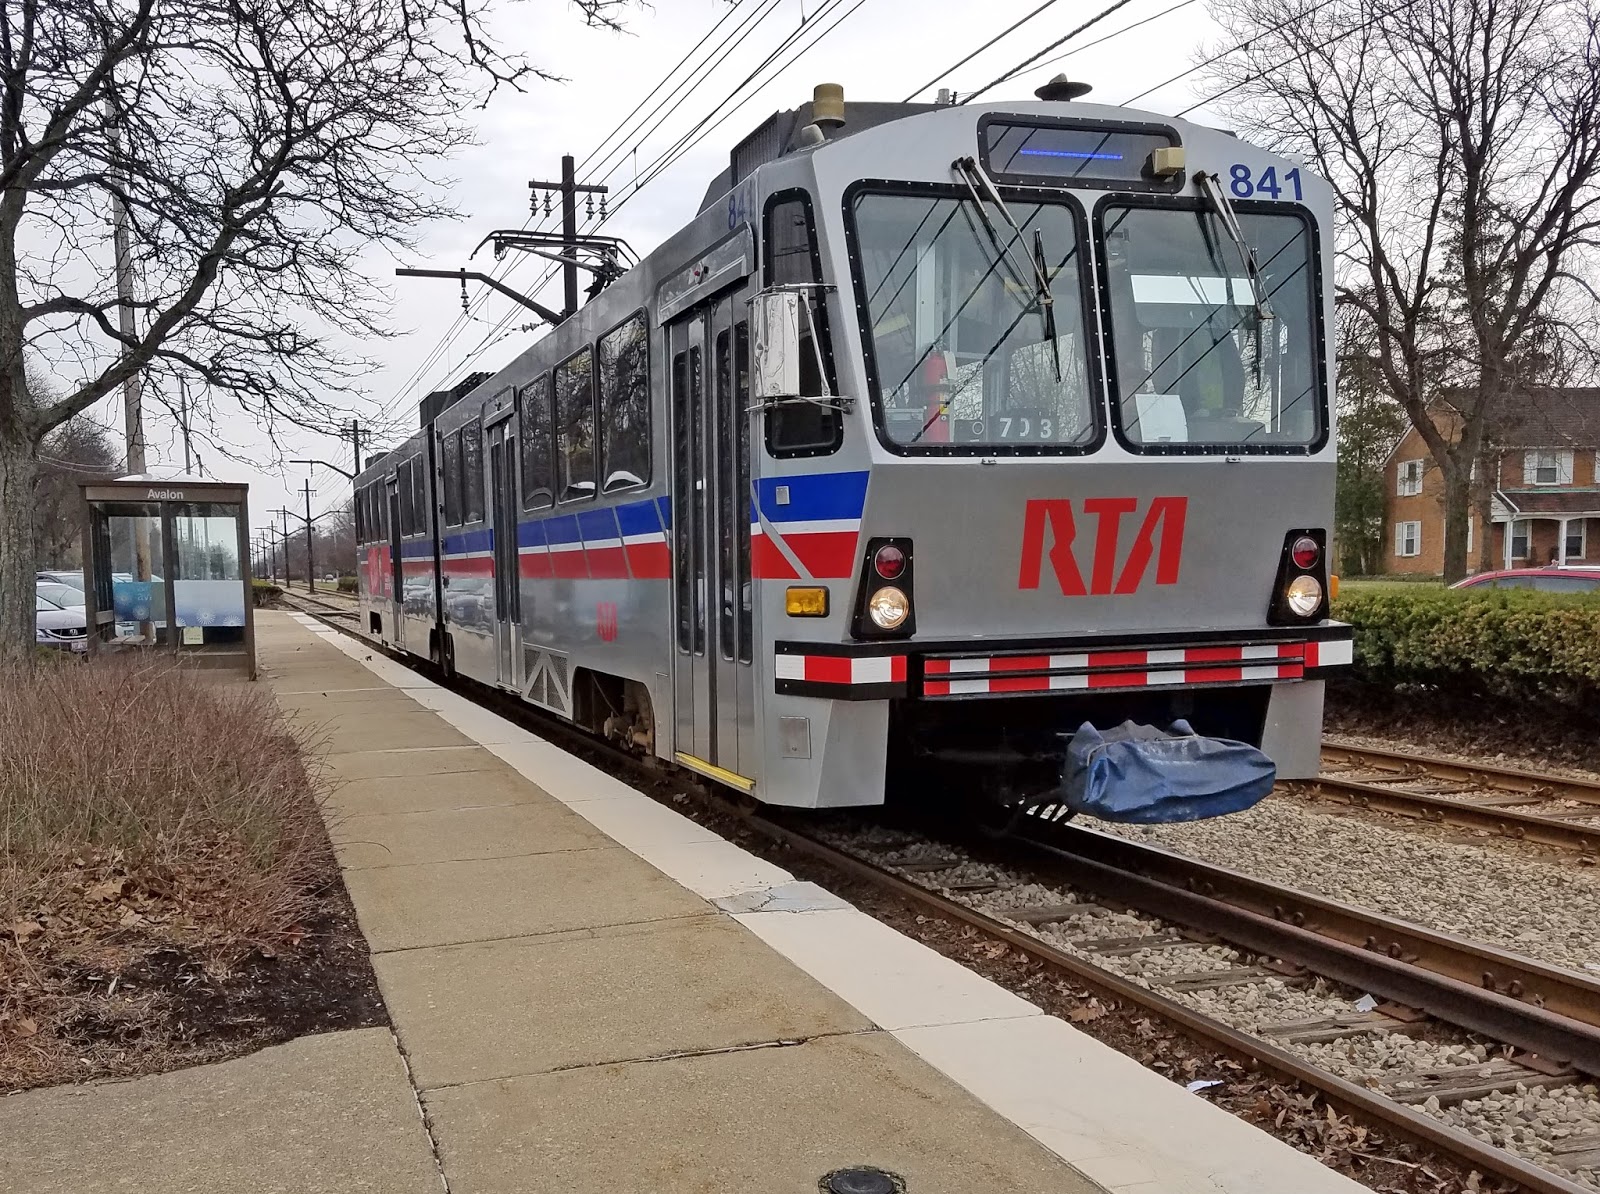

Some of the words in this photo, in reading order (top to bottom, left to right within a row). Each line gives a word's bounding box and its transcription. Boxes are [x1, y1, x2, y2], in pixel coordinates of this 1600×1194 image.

[1229, 163, 1303, 201] 841
[147, 488, 184, 500] Avalon
[1018, 496, 1188, 596] RTA
